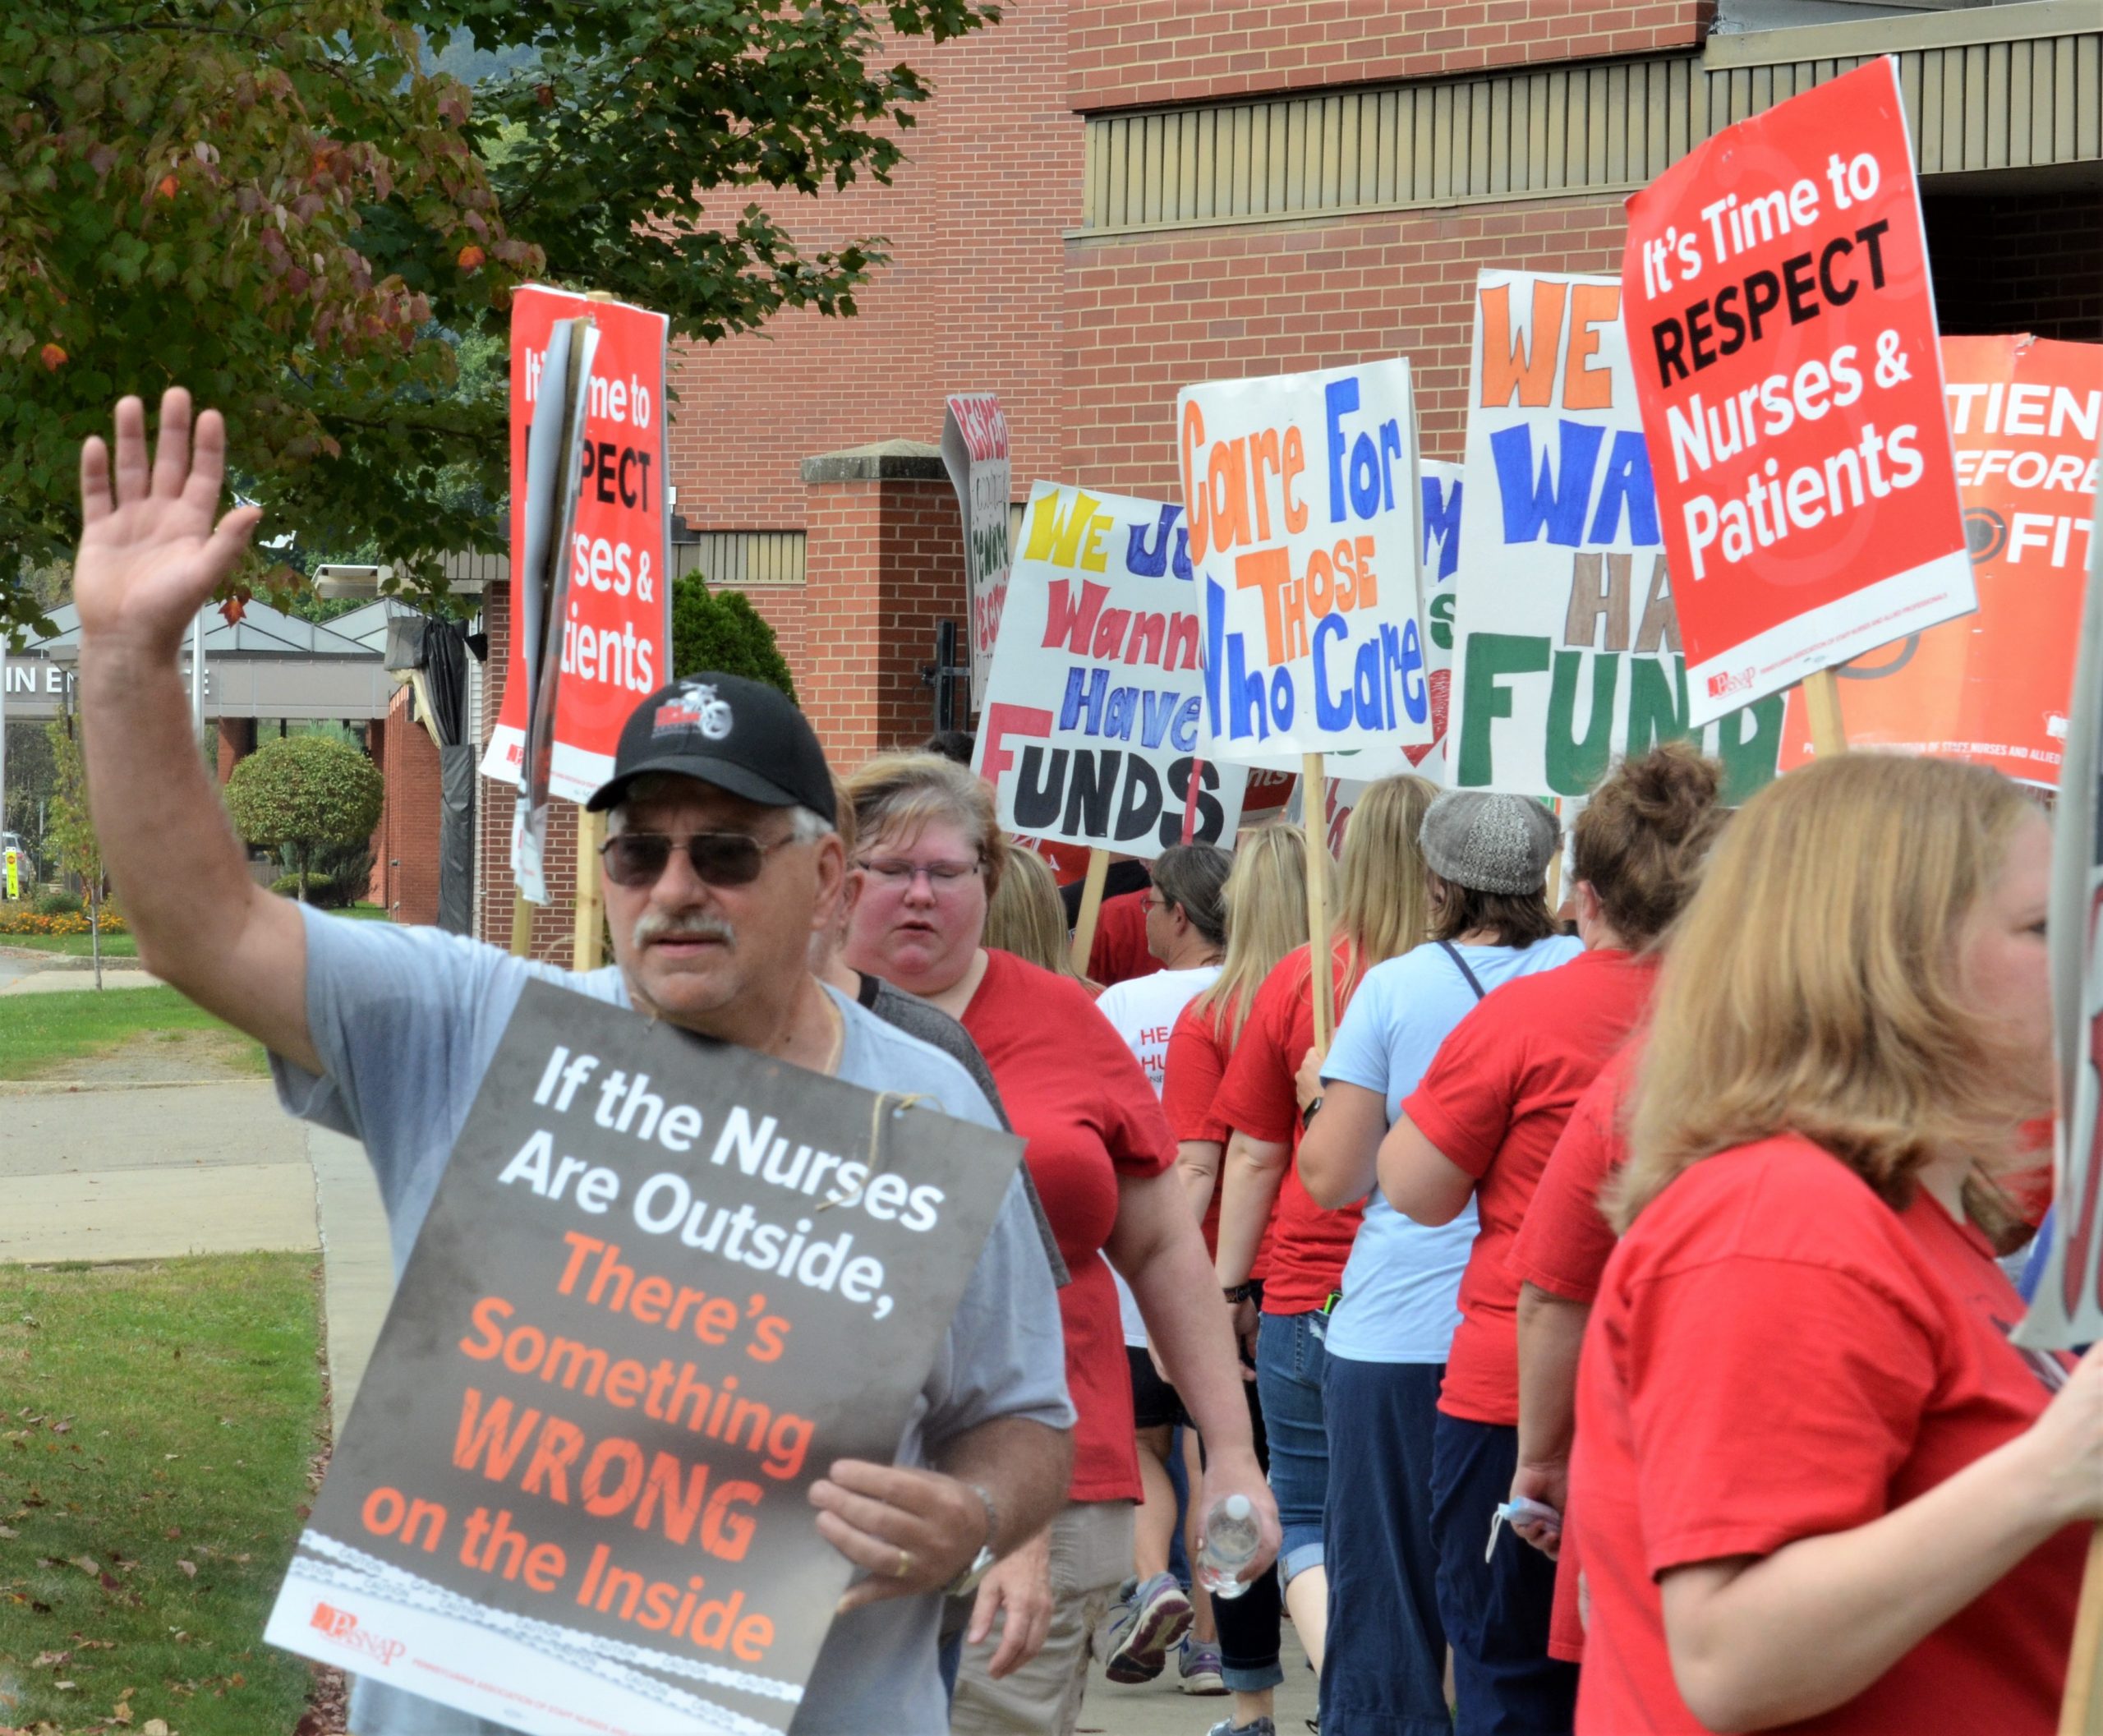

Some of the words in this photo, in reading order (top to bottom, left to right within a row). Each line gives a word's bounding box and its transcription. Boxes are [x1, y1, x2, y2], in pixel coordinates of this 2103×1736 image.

[1643, 226, 1702, 301] It's
[1700, 178, 1820, 265] Time
[1827, 153, 1880, 210] to
[1479, 279, 1622, 410] WE
[1651, 218, 1889, 389] RESPECT
[588, 375, 627, 422] me
[631, 374, 651, 429] to
[1666, 345, 1863, 484] Nurses
[1874, 329, 1912, 389] &
[1945, 383, 2101, 440] TIEN
[1024, 488, 1114, 573] WE
[1125, 504, 1194, 581] Ju
[1182, 399, 1309, 567] Care
[1325, 377, 1401, 523] For
[1490, 419, 1661, 548] WA
[1682, 423, 1925, 582] Patients
[1954, 450, 2096, 494] EFORE
[573, 532, 631, 596] ses
[637, 550, 653, 602] &
[1041, 578, 1206, 672] Wann
[1235, 535, 1378, 666] THOSE
[1564, 552, 1683, 654] HA
[560, 601, 652, 693] tients
[1059, 666, 1201, 753] Have
[1312, 612, 1428, 733] Care
[980, 702, 1225, 850] FUNDS
[1971, 742, 2007, 756] NURSES
[2009, 746, 2028, 758] AND
[2029, 748, 2061, 765] ALLIED
[533, 1046, 599, 1112] If
[596, 1069, 702, 1151] the
[711, 1106, 946, 1232] Nurses
[498, 1130, 619, 1214] Are
[633, 1172, 895, 1319] Outside,
[558, 1231, 792, 1363] There's
[459, 1296, 816, 1480] Something
[453, 1388, 764, 1562] WRONG
[361, 1486, 449, 1553] on
[459, 1507, 567, 1592] the
[576, 1543, 775, 1663] Inside
